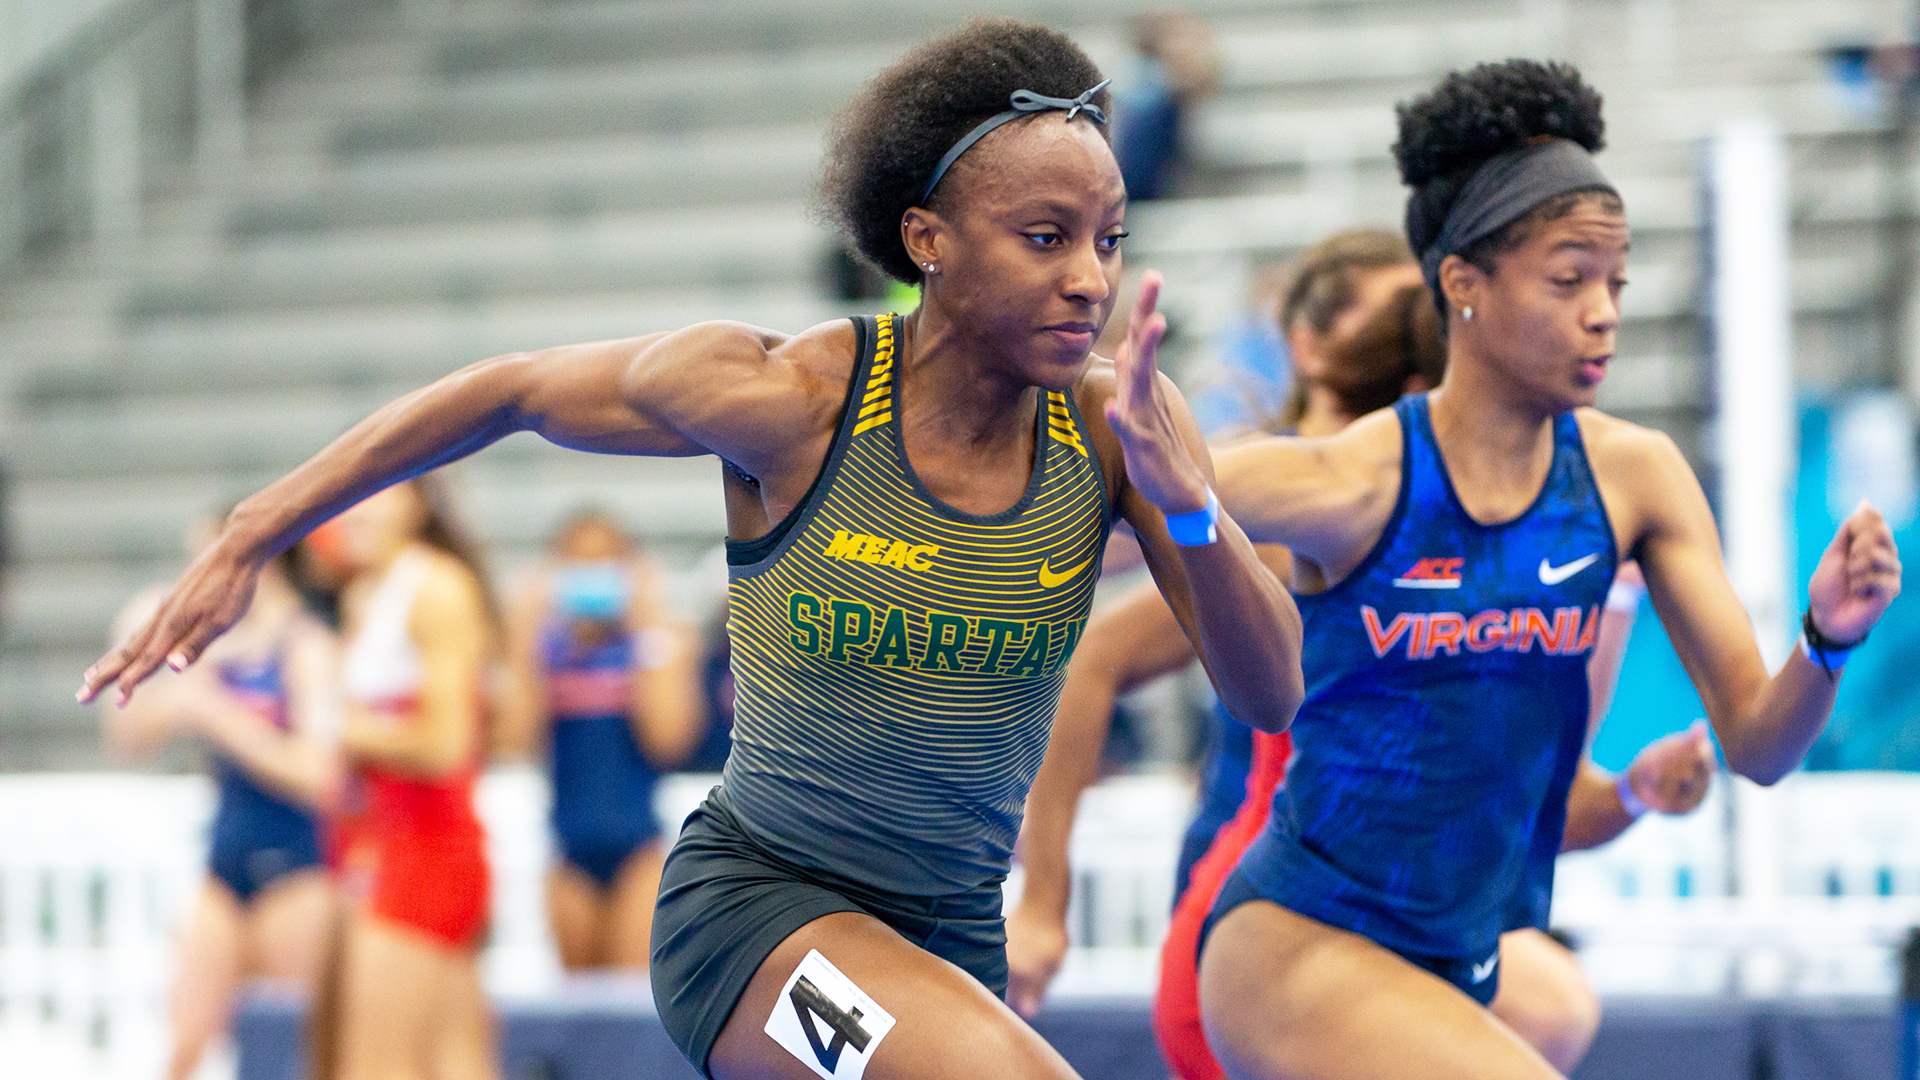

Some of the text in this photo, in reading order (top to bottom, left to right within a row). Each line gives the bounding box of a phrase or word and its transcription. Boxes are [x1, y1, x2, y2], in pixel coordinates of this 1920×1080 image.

[823, 529, 940, 573] MEAC
[1400, 556, 1465, 580] ACC
[1359, 603, 1599, 660] VIRGINIA
[789, 974, 873, 1076] 4
